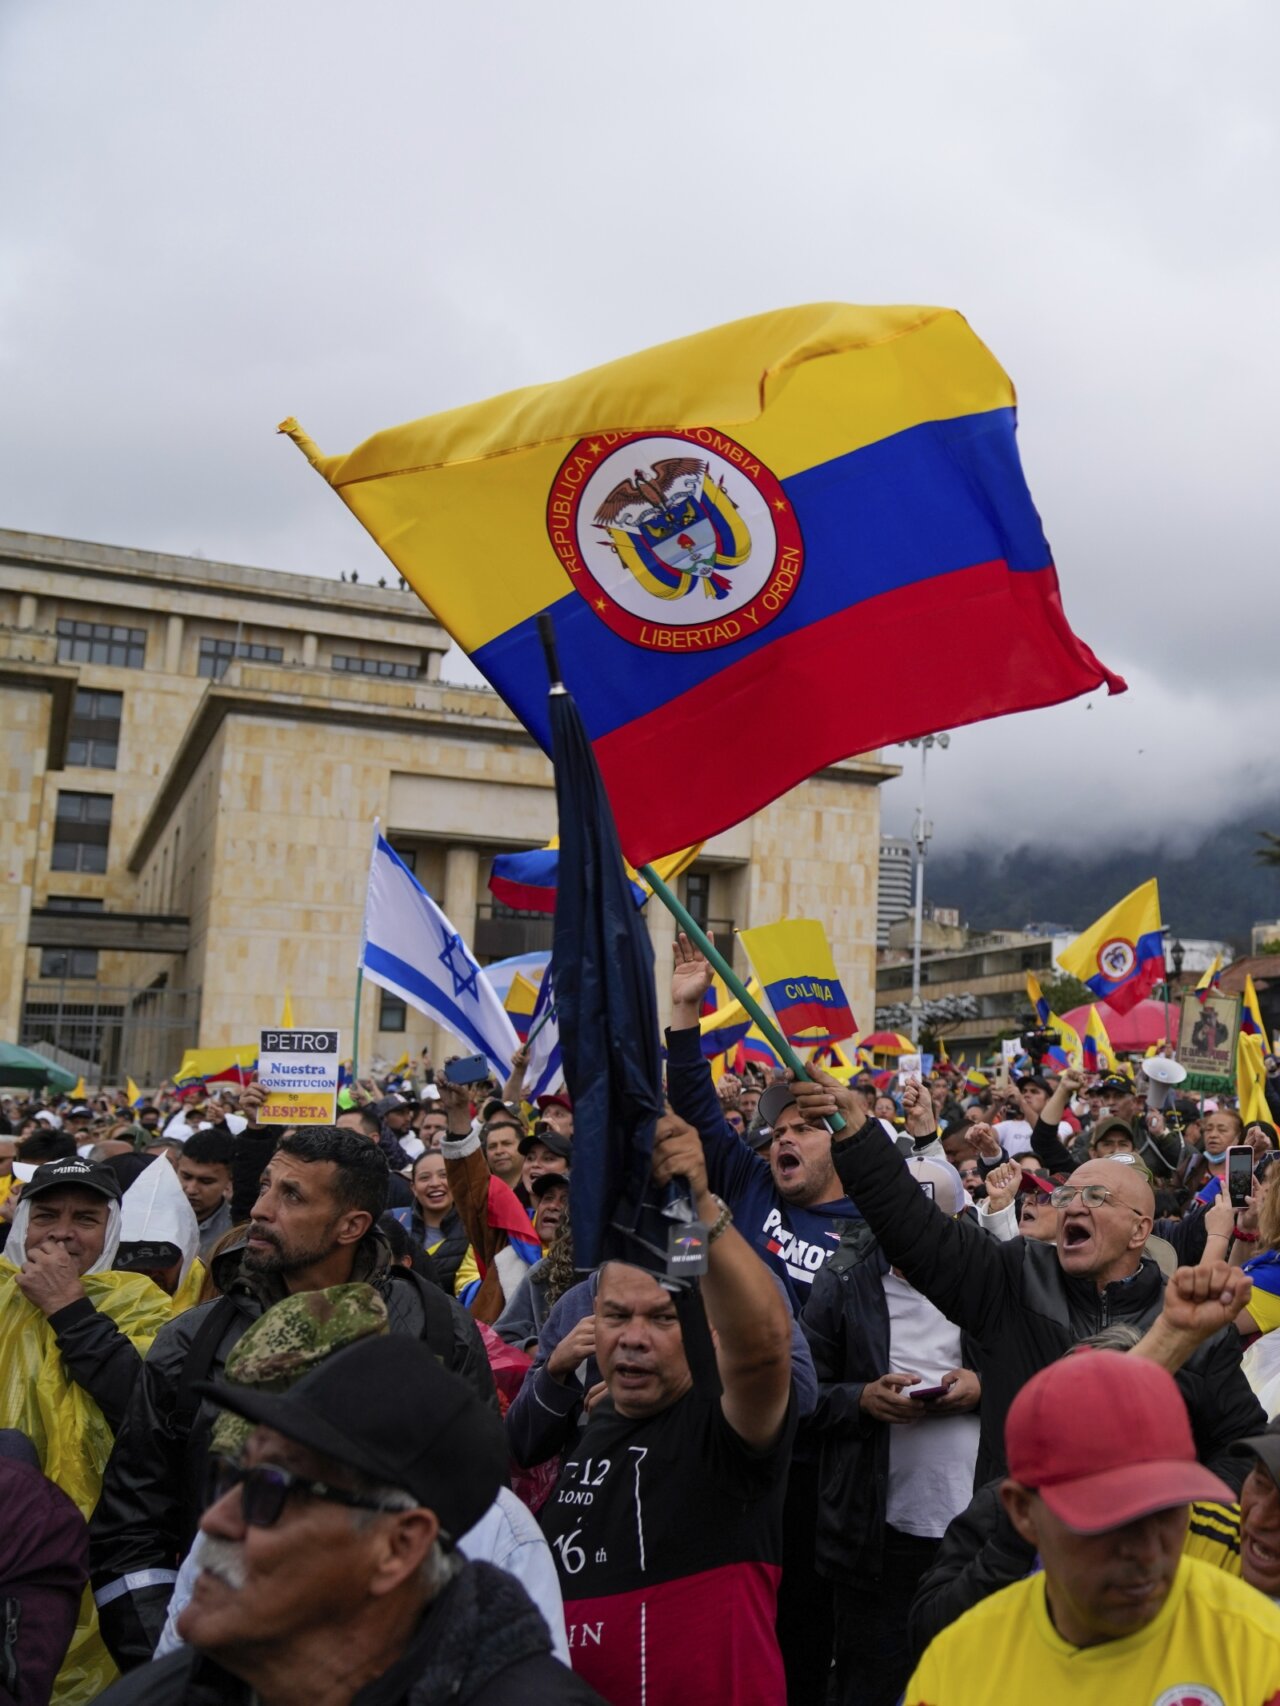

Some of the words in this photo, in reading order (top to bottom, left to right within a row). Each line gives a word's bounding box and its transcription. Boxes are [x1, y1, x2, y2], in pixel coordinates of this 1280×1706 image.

[553, 457, 593, 574] REPUBLICA
[672, 426, 762, 478] LOMBIA
[639, 619, 741, 649] LIBERTAD
[743, 607, 760, 627] Y
[762, 546, 800, 611] ORDEN
[266, 1034, 329, 1051] PETRO
[270, 1062, 326, 1075] Nuestra
[260, 1079, 336, 1088] CONSTITUCION
[262, 1105, 329, 1118] RESPETA
[595, 1547, 607, 1563] th
